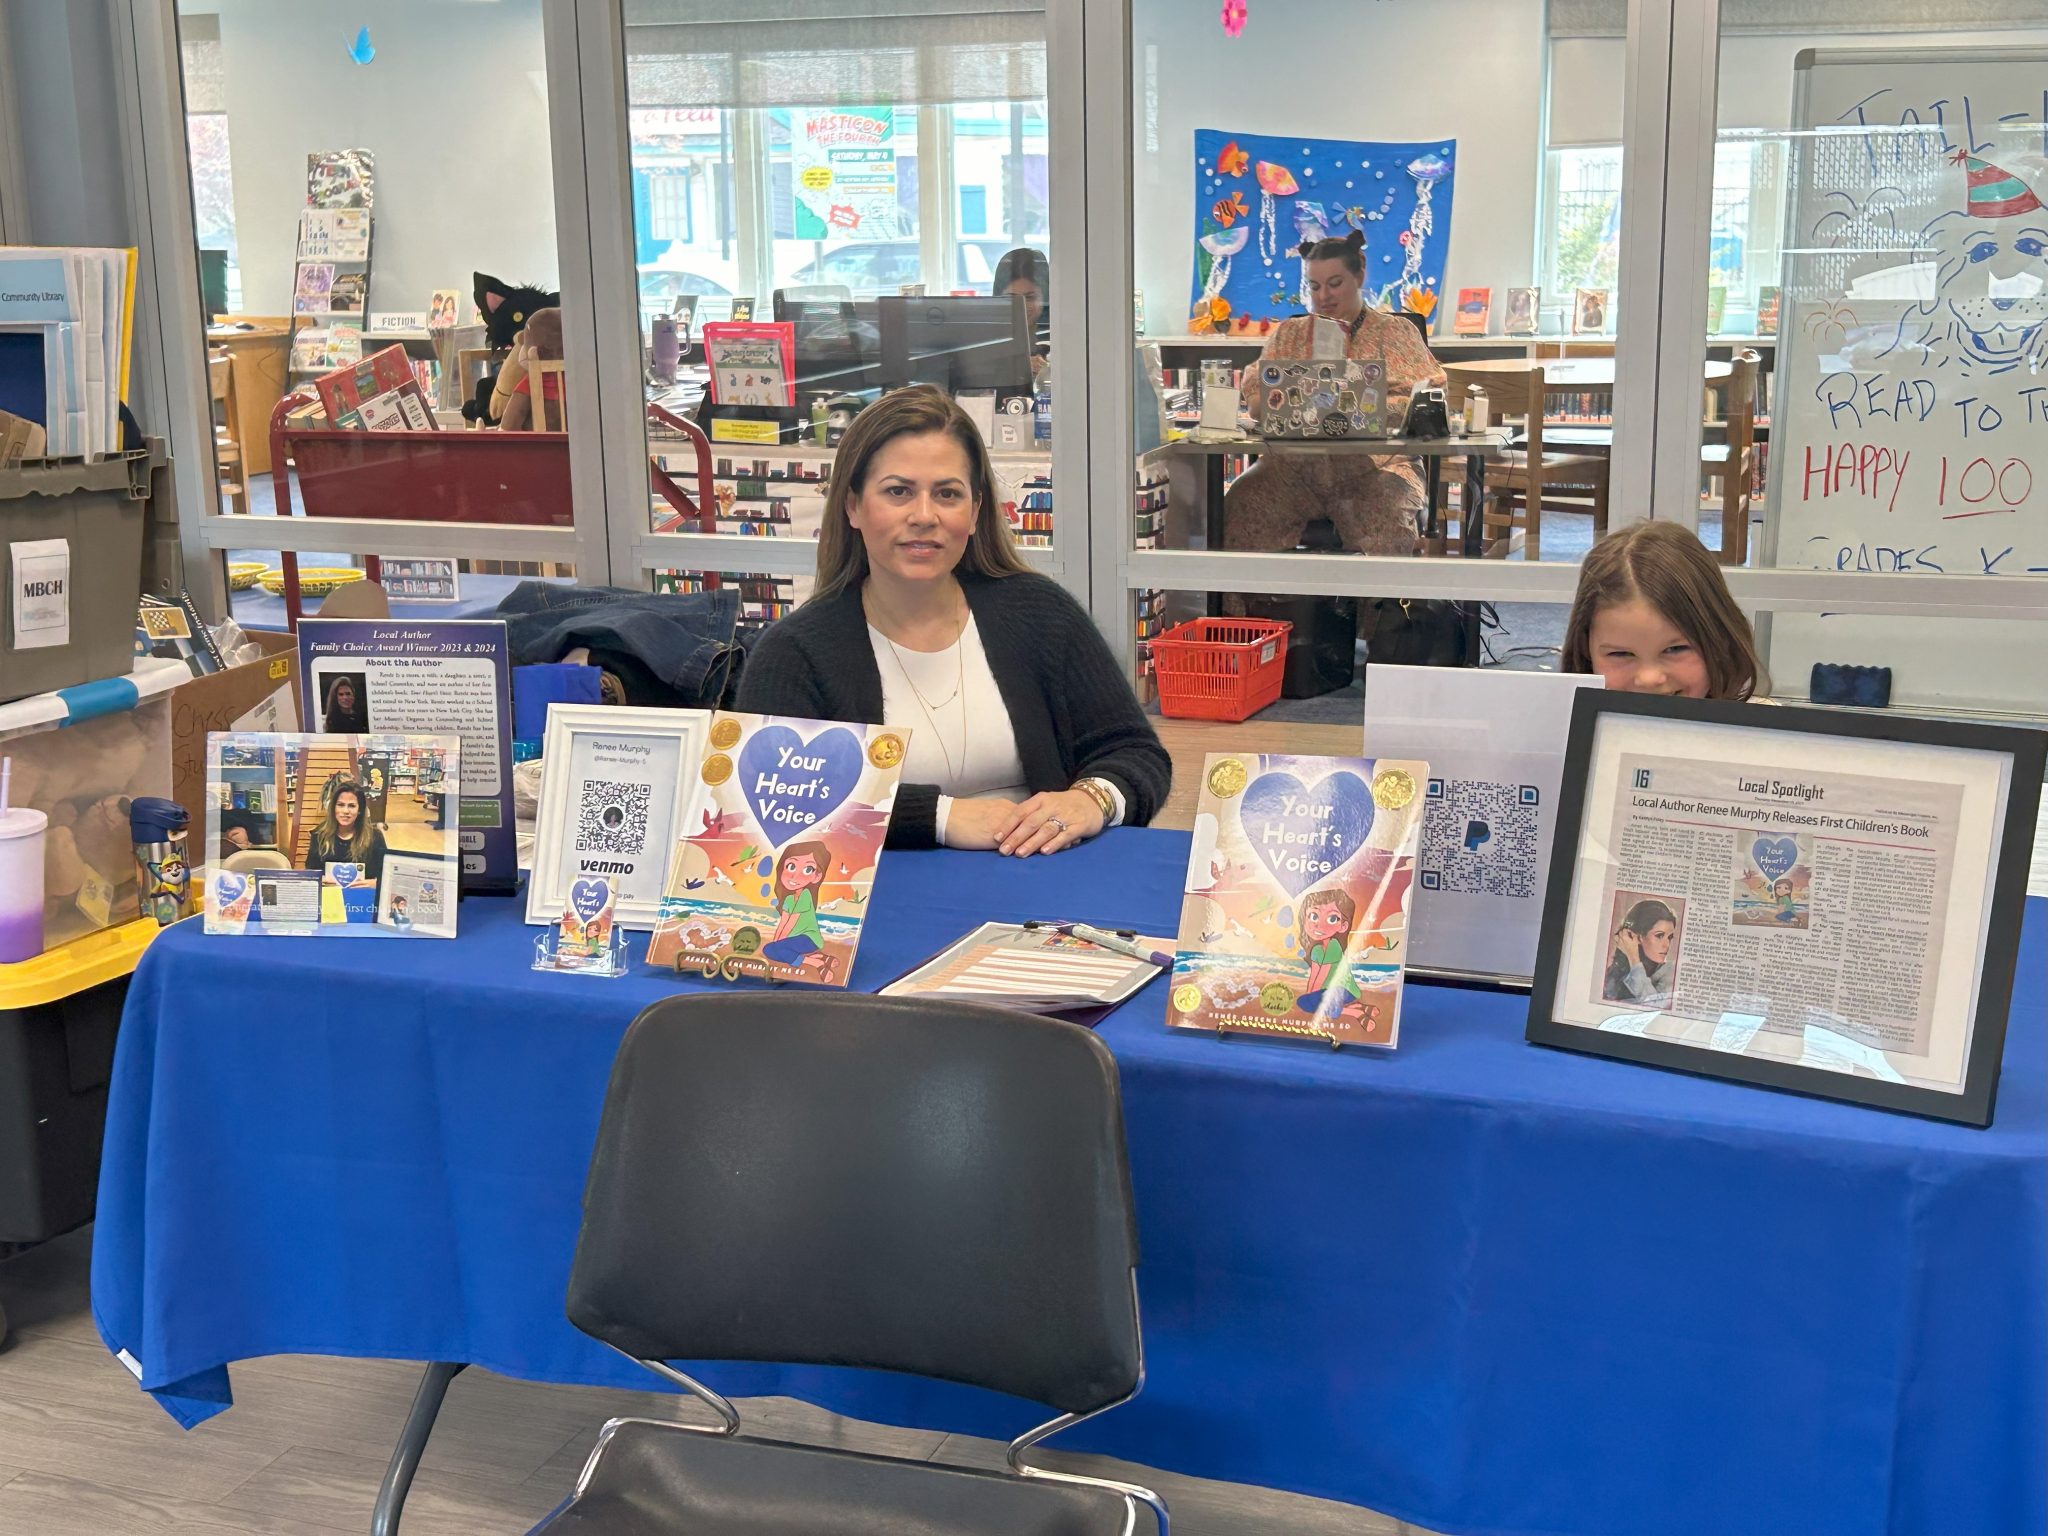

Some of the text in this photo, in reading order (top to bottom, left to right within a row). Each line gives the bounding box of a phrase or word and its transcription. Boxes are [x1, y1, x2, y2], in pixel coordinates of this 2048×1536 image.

[806, 116, 887, 136] MASTICON
[1, 292, 65, 302] Community Library
[382, 317, 416, 327] FICTION
[1816, 372, 1936, 430] READ
[1955, 397, 2002, 438] TO
[1803, 442, 2032, 512] HAPPY 100
[1808, 536, 1944, 573] RADES
[23, 579, 64, 598] MBCH
[373, 629, 432, 639] Local Author
[310, 642, 496, 653] Family Choice Award Winner 2023 & 2024
[365, 658, 443, 668] About the Author
[592, 741, 651, 755] Renee Murphy
[778, 746, 826, 772] Your
[755, 772, 830, 799] Heart's
[1635, 769, 1650, 788] 16
[1738, 777, 1769, 794] Local
[1771, 781, 1825, 801] Spotlight
[759, 799, 816, 825] Voice
[1279, 795, 1333, 818] Your
[1632, 796, 1929, 838] Local Author Renee Murphy Releases First Children's Book
[1263, 823, 1342, 847] Heart's
[581, 860, 634, 874] venmo
[1269, 849, 1332, 873] Voice
[1282, 1018, 1319, 1029] MURPH
